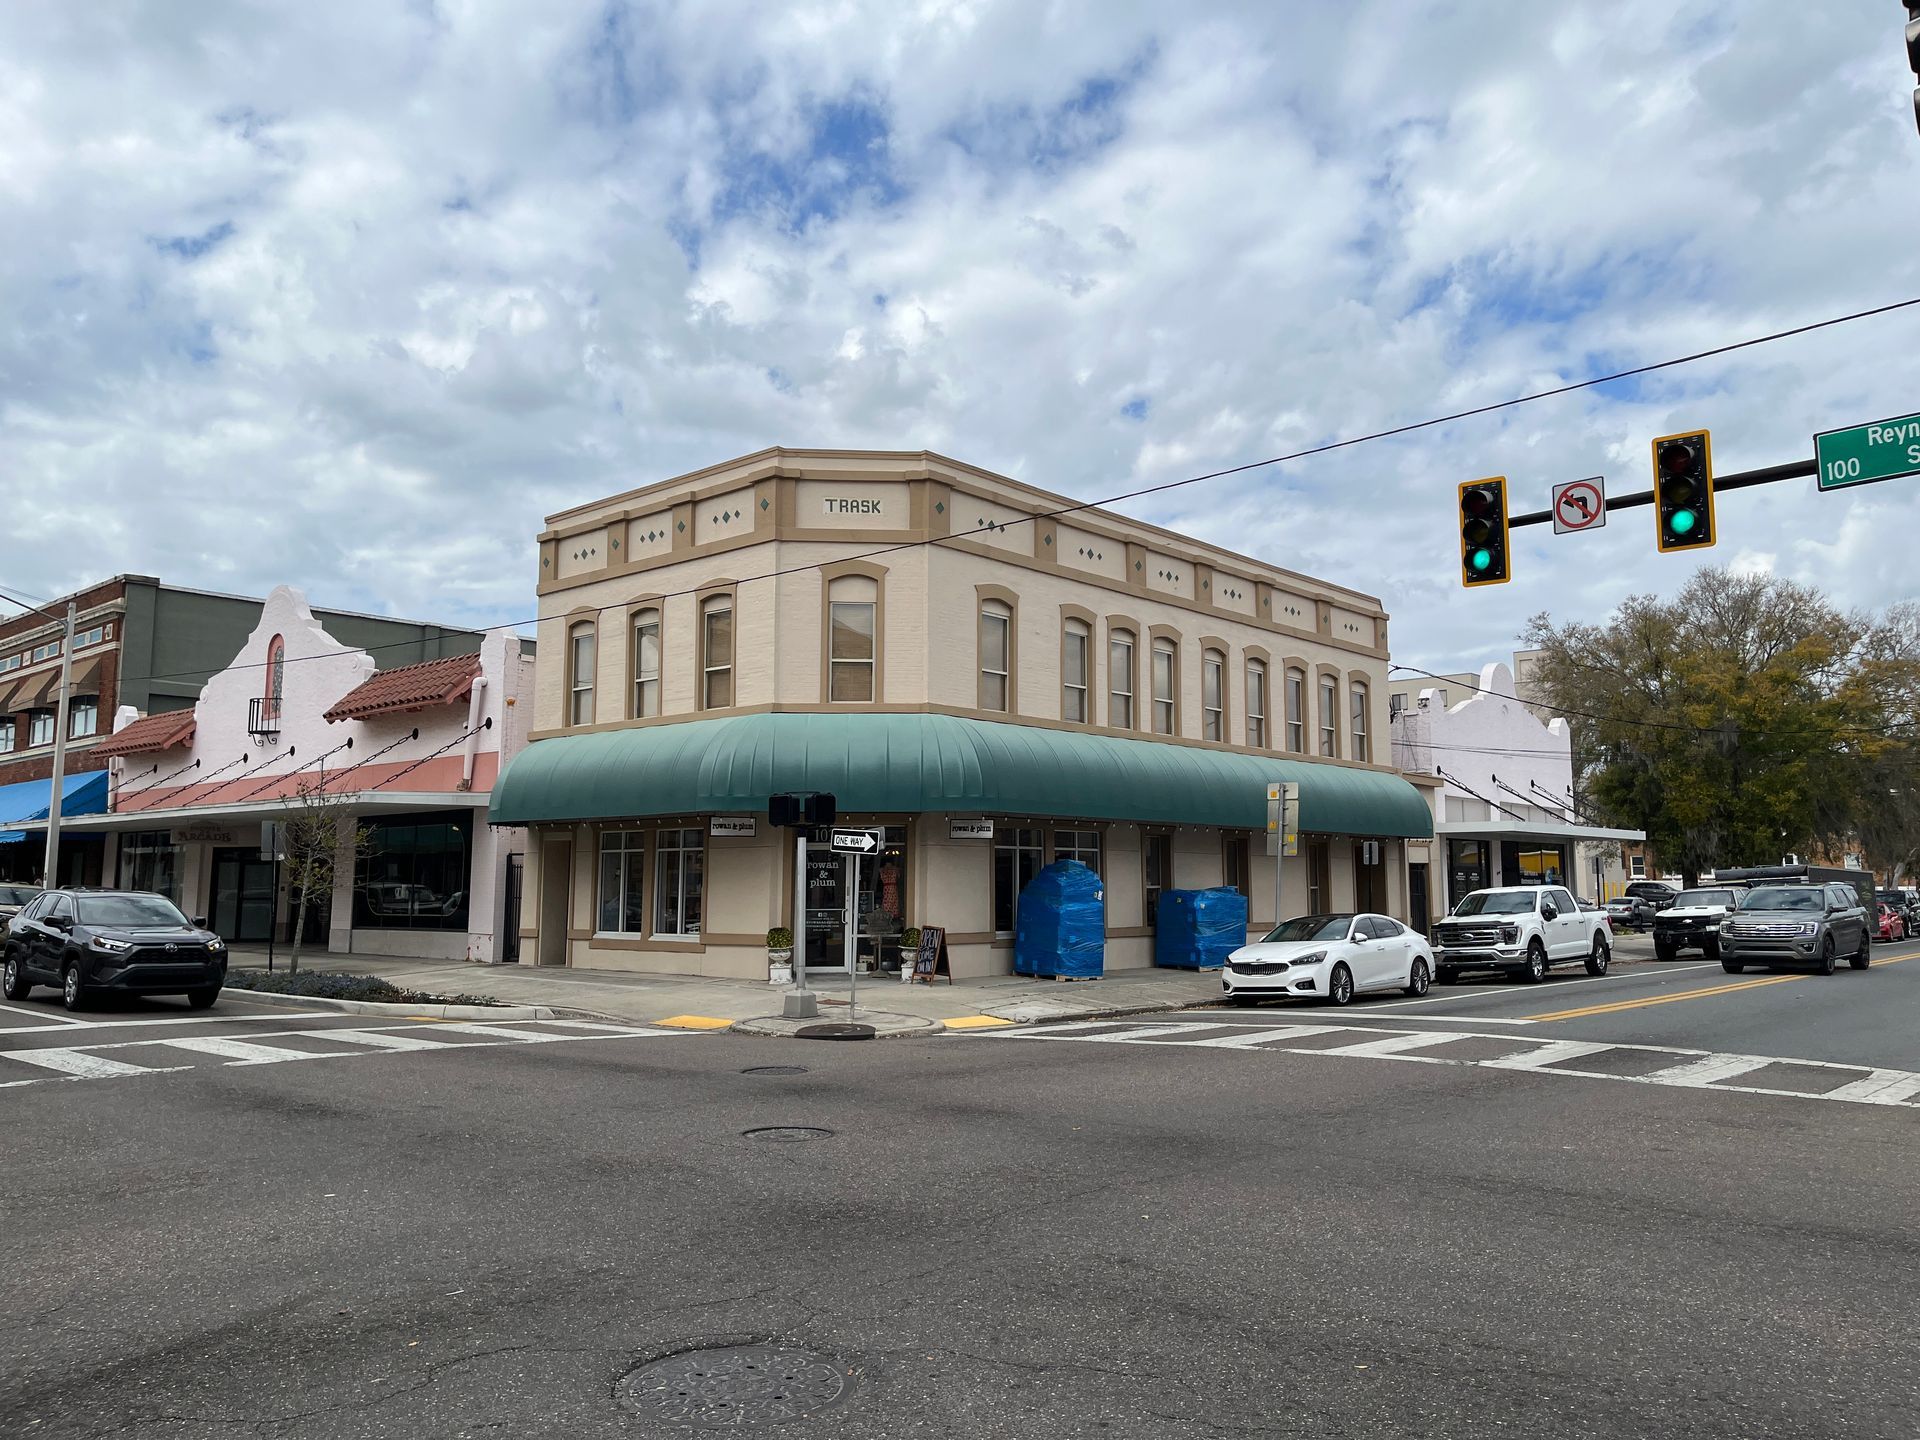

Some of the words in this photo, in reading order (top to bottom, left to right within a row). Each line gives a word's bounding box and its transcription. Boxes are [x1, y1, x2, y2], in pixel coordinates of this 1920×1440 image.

[1826, 457, 1860, 481] 100
[825, 499, 881, 514] TRASK
[835, 836, 849, 845] ONE
[850, 837, 864, 846] WAY
[807, 861, 840, 869] rowan
[819, 870, 829, 879] &
[810, 879, 836, 888] plum
[921, 929, 940, 948] OPEN
[918, 950, 934, 961] COME
